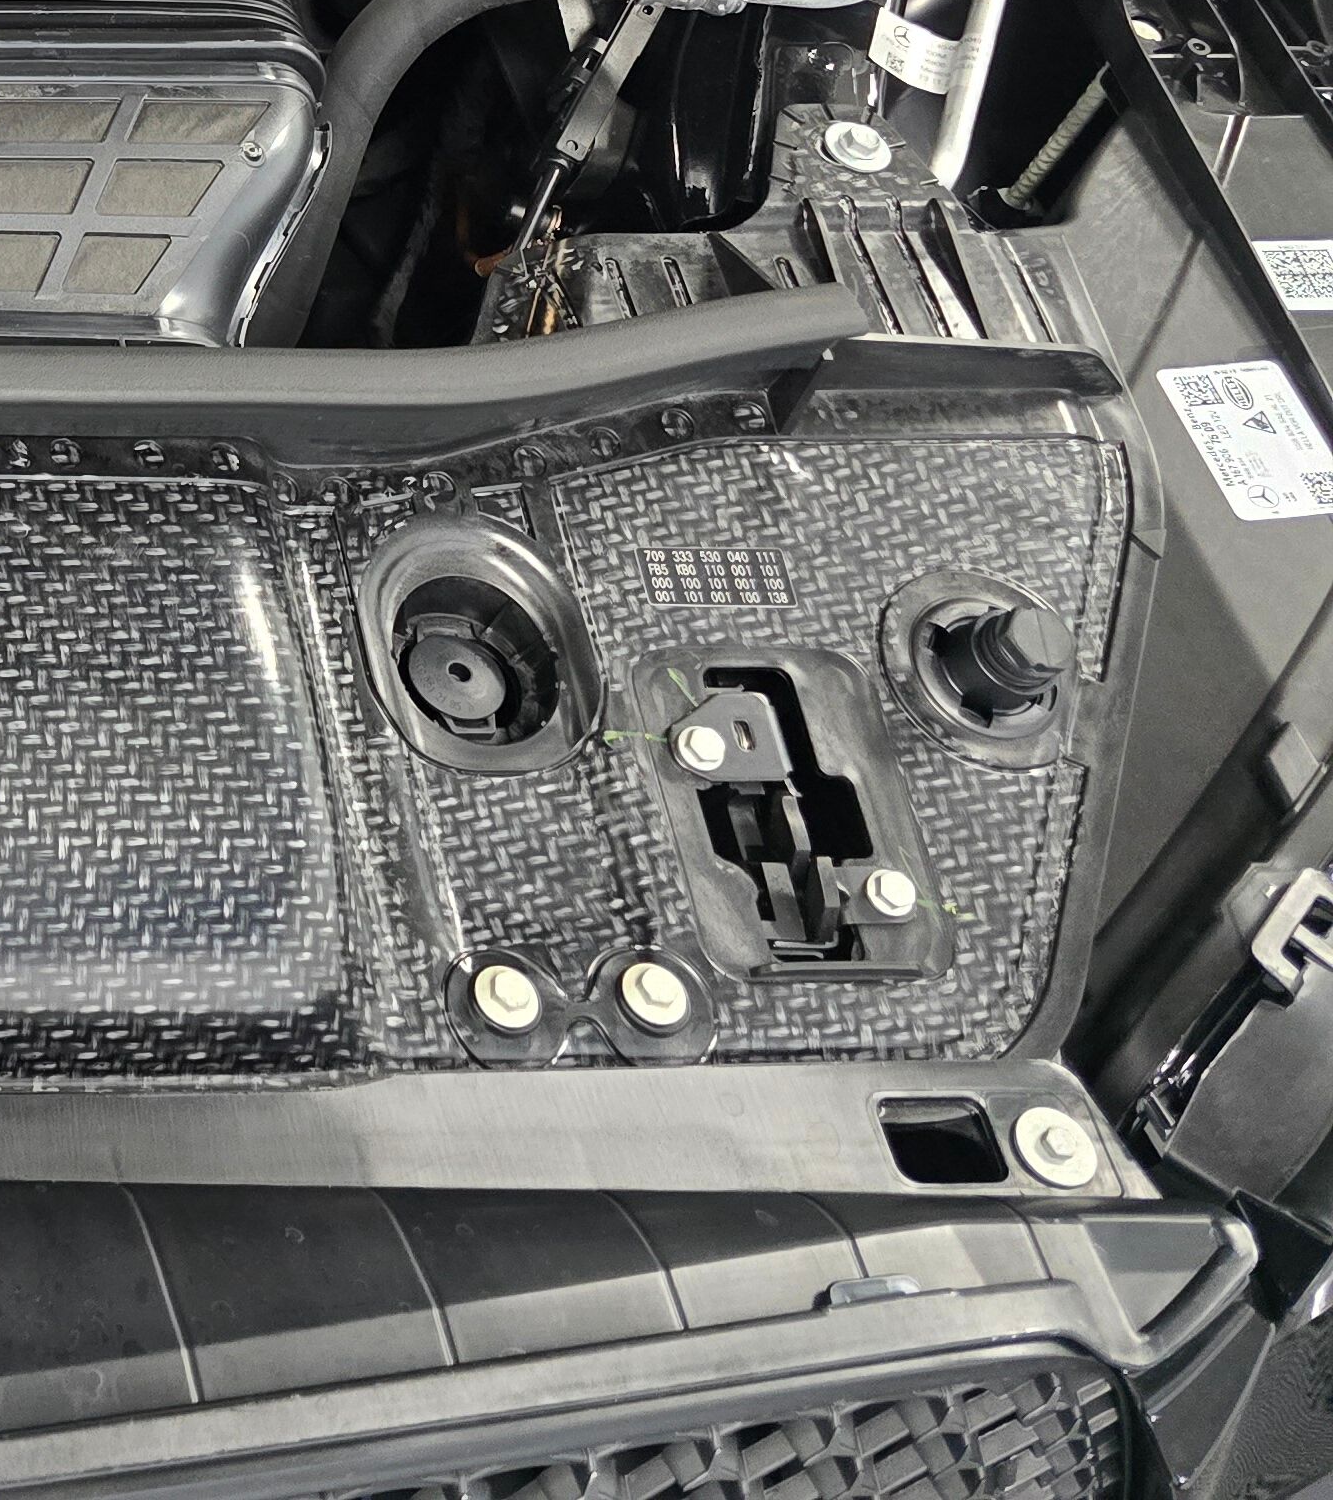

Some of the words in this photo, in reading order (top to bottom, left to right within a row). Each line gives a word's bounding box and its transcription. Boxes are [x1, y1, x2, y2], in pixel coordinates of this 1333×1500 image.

[1184, 408, 1201, 430] Benz
[1203, 440, 1234, 487] Mercedes
[643, 550, 665, 562] 709
[672, 550, 694, 562] 333
[699, 551, 721, 563] 530
[727, 551, 749, 563] 040
[756, 552, 776, 563] 111
[648, 564, 669, 576] FB5
[704, 565, 725, 576] 110
[731, 565, 752, 576] 001
[759, 565, 780, 577] 101
[652, 577, 673, 589] 000
[680, 577, 701, 589] 100
[708, 578, 728, 589] 101
[734, 578, 755, 590] 001
[763, 578, 784, 590] 100
[655, 591, 676, 602] 001
[684, 591, 704, 603] 101
[710, 591, 732, 603] 001
[740, 592, 760, 603] 100
[767, 592, 788, 604] 138
